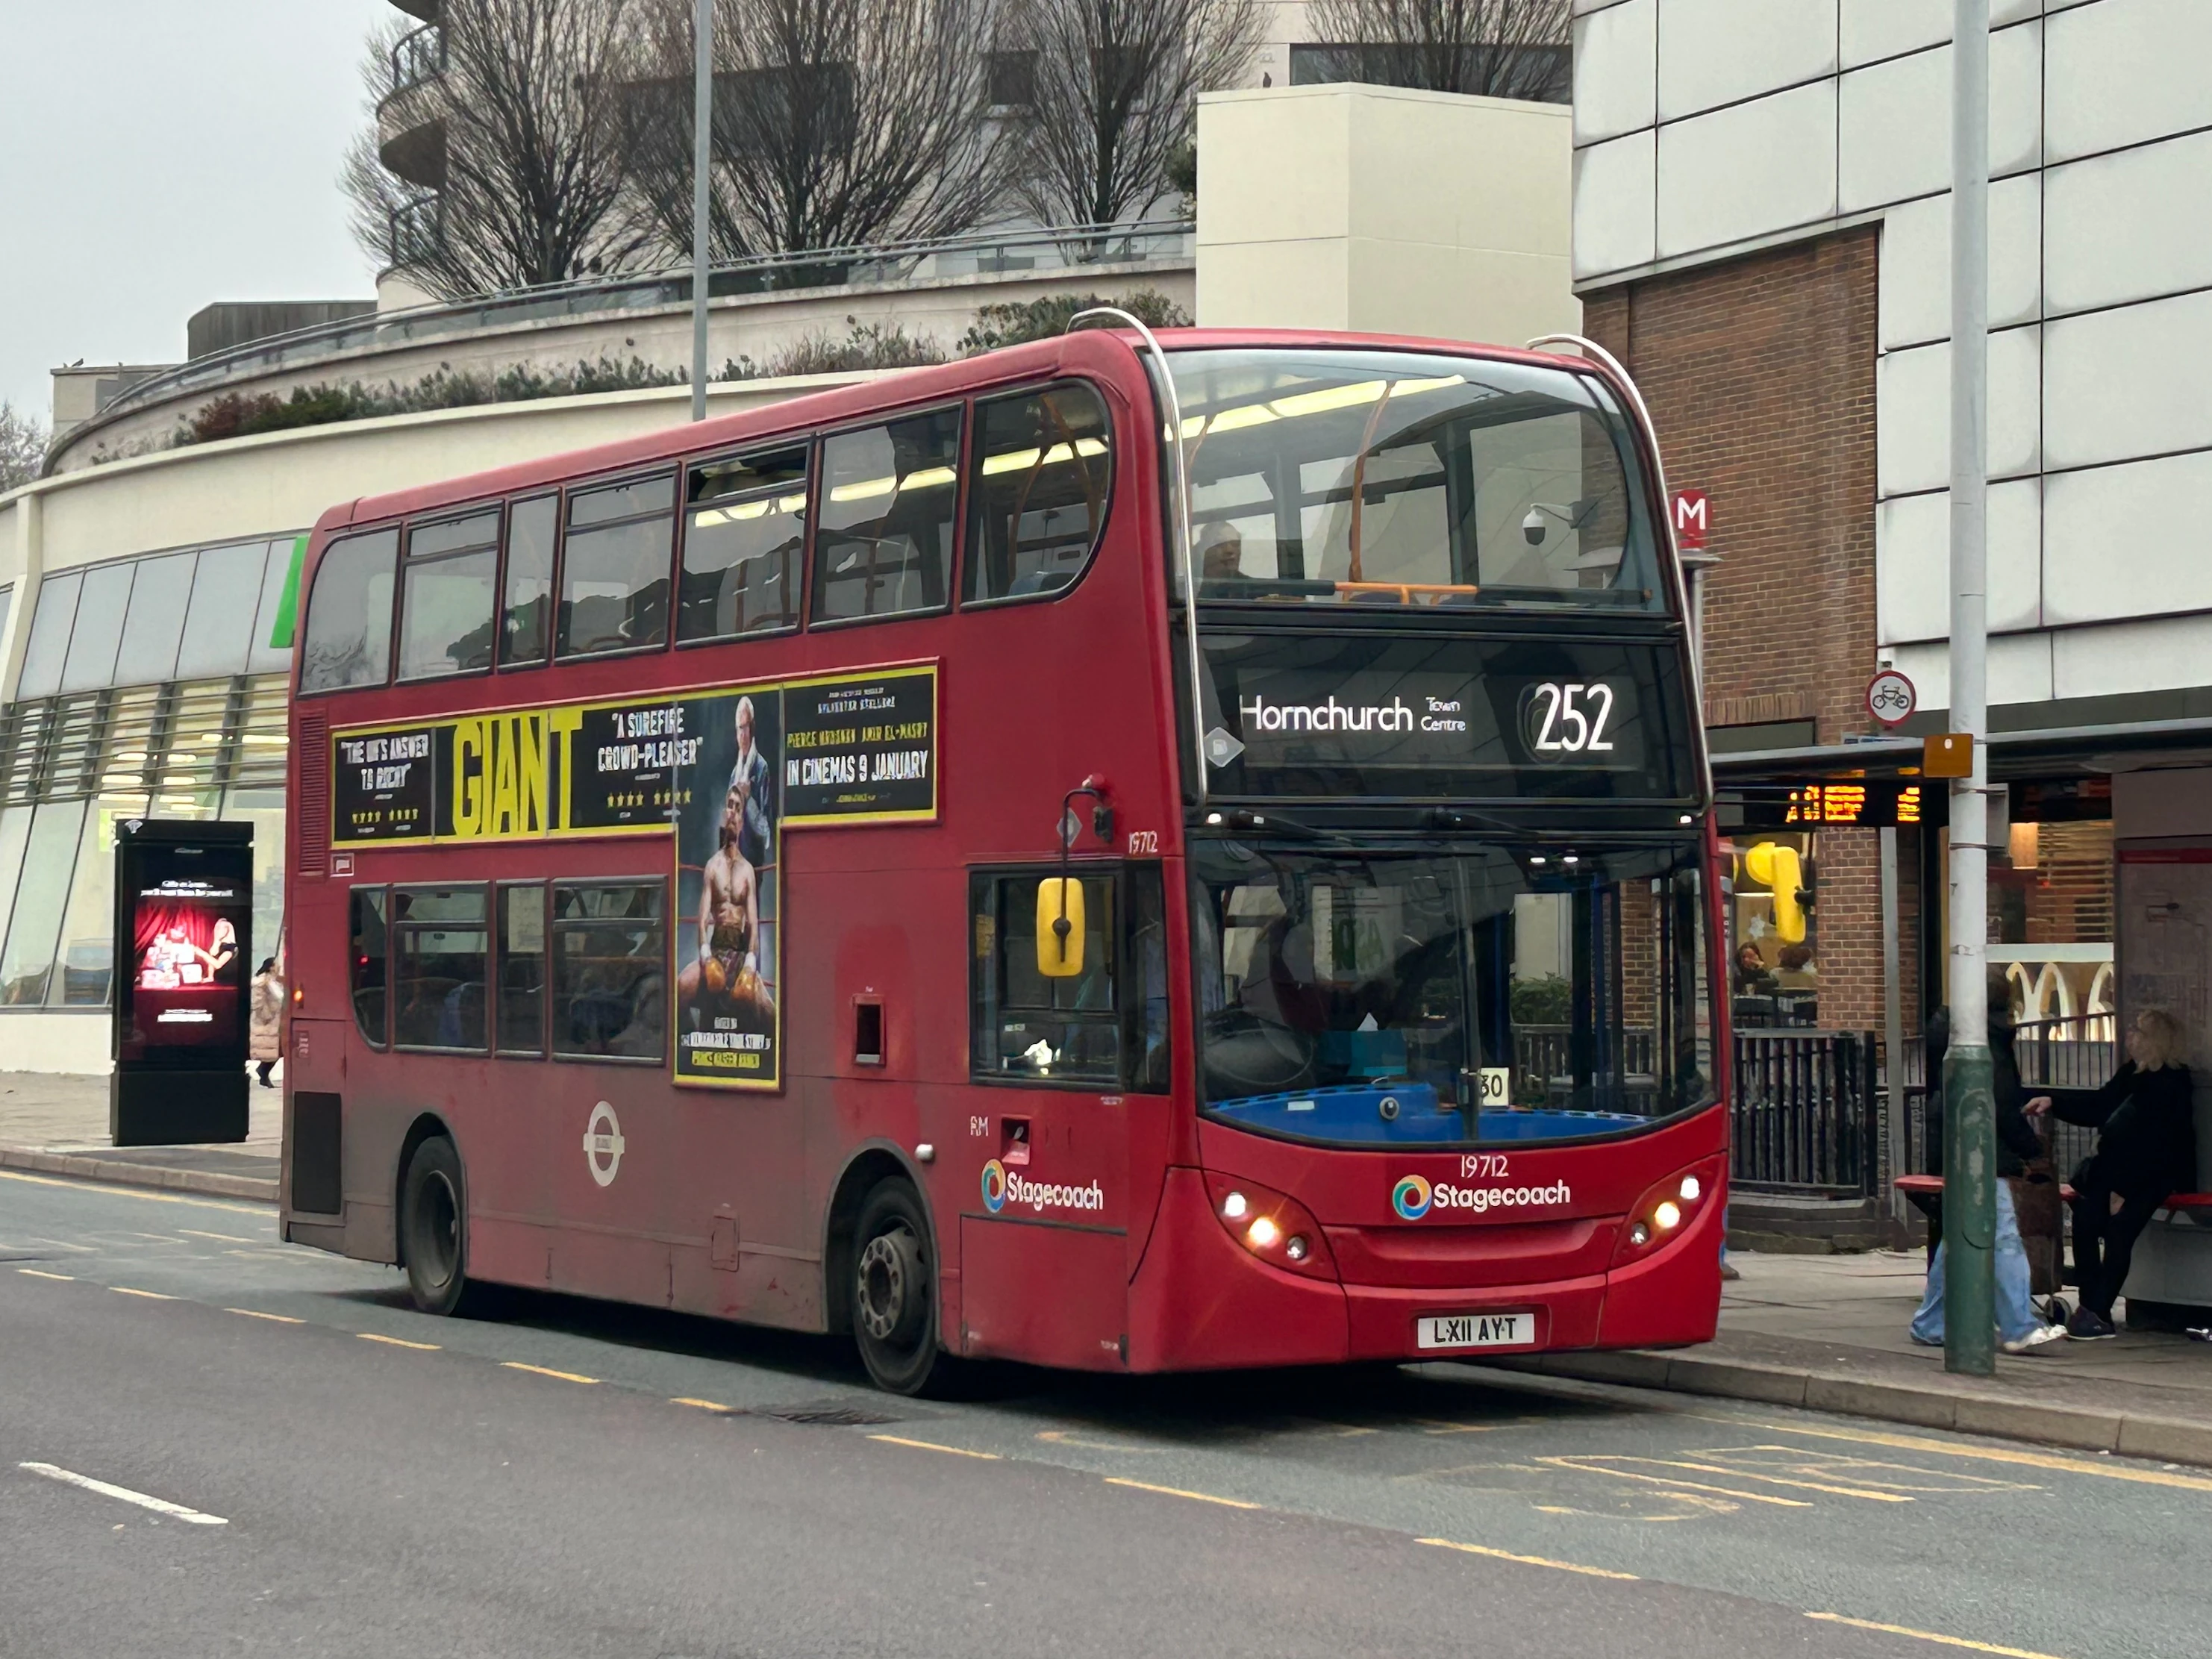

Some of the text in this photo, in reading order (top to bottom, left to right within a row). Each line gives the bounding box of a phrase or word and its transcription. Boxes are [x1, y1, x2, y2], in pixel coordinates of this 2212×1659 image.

[1678, 497, 1706, 530] M
[1239, 694, 1413, 731] Hornchurch
[1425, 696, 1460, 712] Town
[1535, 682, 1613, 752] 252
[627, 707, 684, 738] SUREFIRE
[1420, 715, 1466, 731] Centre
[452, 709, 584, 837] GIANT
[786, 749, 928, 787] IN CINEMAS 9 JANUARY
[1128, 829, 1158, 855] 19712
[970, 1116, 990, 1137] RM
[1460, 1155, 1510, 1178] 19712
[1007, 1170, 1104, 1212] Stagecoach
[1433, 1178, 1571, 1213] Stagecoach
[1434, 1316, 1517, 1343] LX11 AYT
